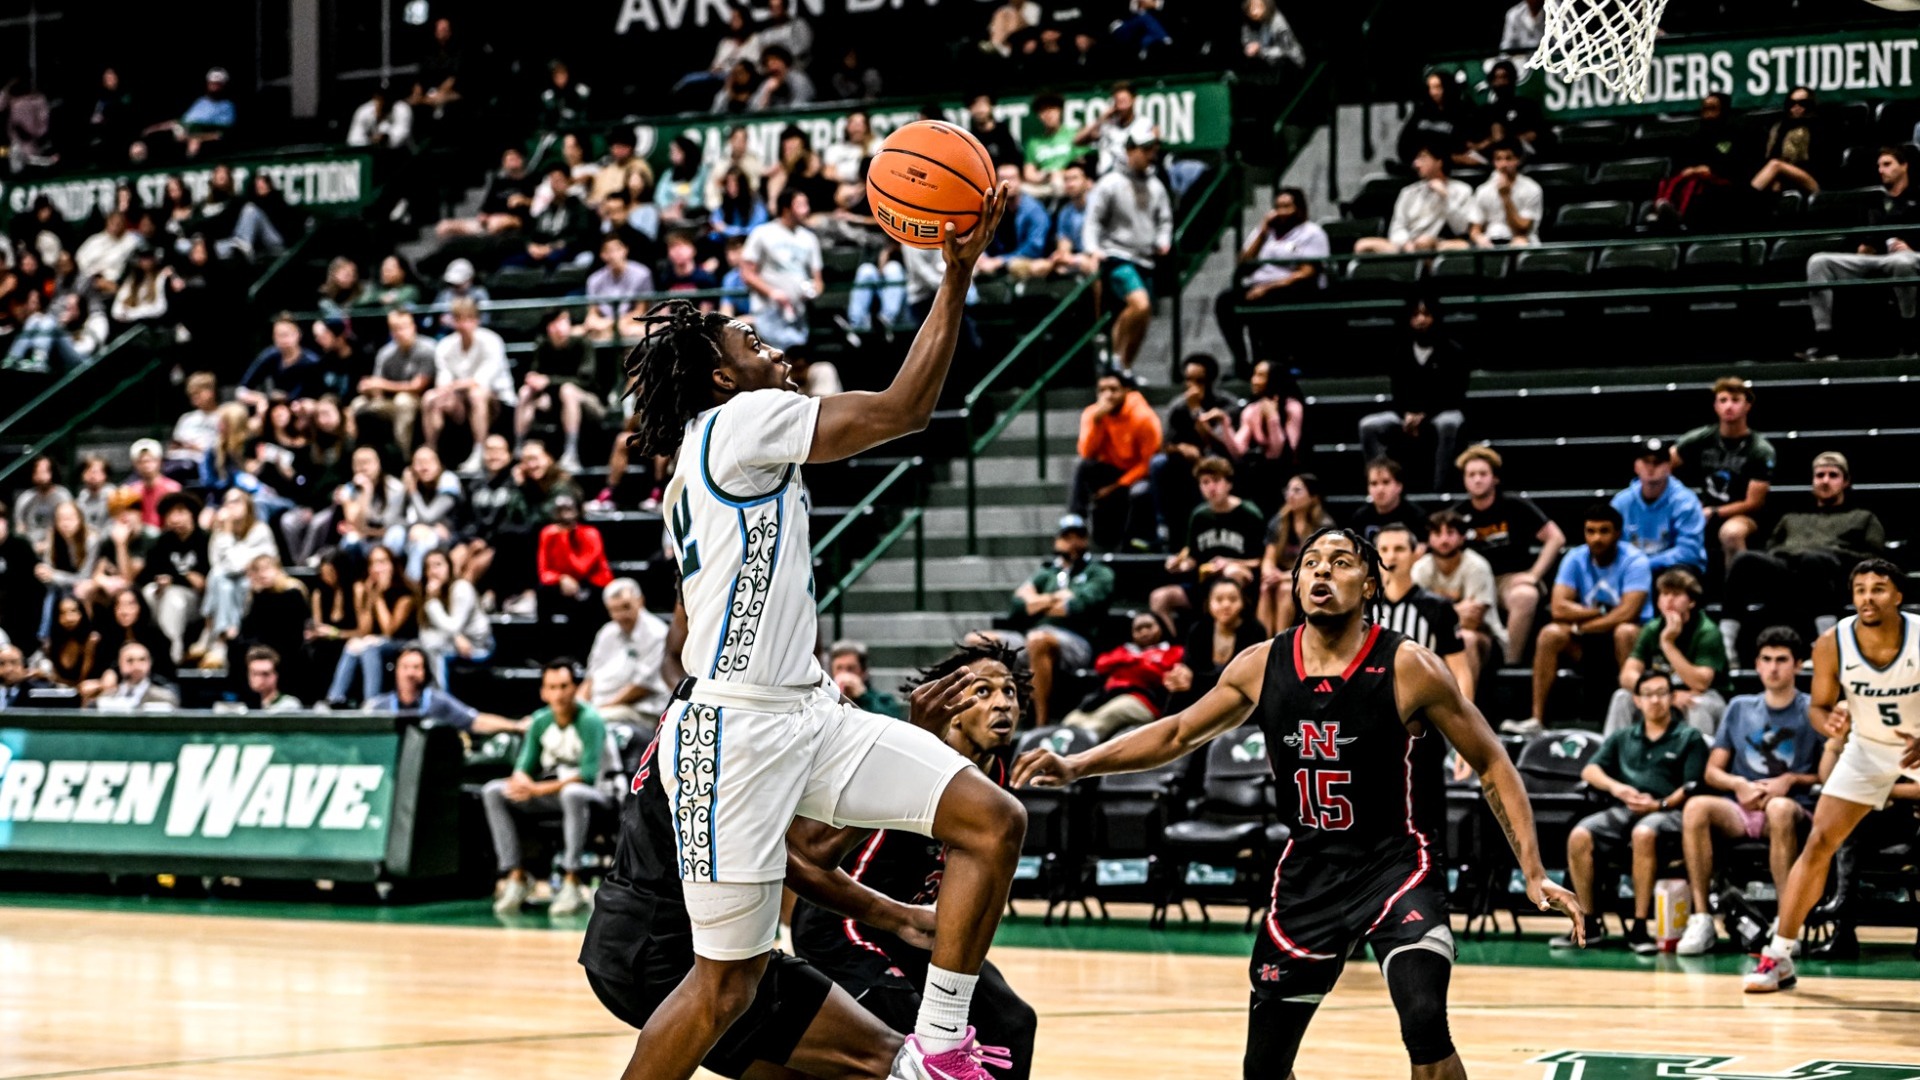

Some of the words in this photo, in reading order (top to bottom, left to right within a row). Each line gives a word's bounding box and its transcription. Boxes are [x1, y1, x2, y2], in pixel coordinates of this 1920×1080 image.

[1747, 39, 1919, 96] STUDENT
[877, 204, 939, 239] ELITE
[1878, 702, 1902, 727] 5
[1299, 720, 1340, 761] N
[1294, 768, 1354, 831] 15
